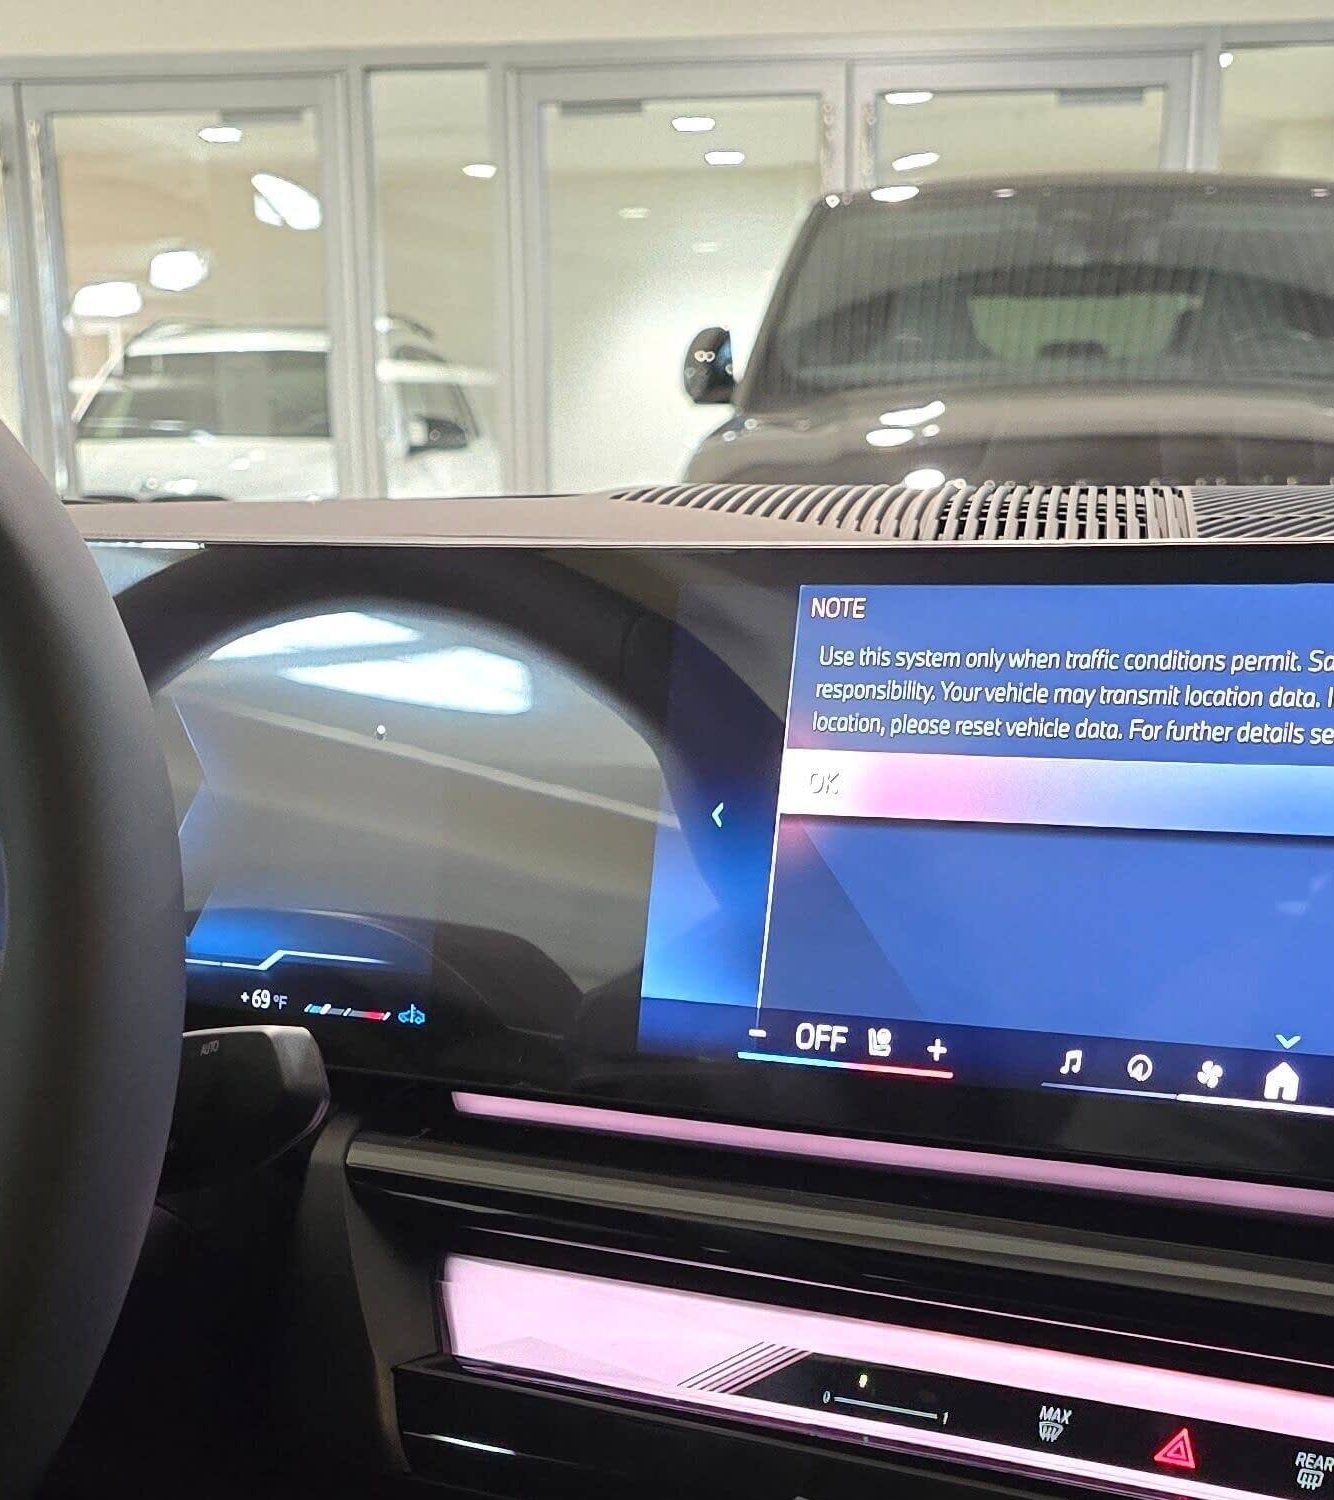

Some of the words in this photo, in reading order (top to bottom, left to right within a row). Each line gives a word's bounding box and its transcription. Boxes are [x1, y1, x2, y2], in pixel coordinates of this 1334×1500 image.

[810, 597, 866, 619] NOTE
[819, 645, 855, 667] Use
[859, 646, 891, 668] this
[895, 648, 961, 671] system
[965, 648, 1005, 673] only
[1008, 648, 1061, 670] when
[1065, 649, 1120, 671] traffic
[1123, 649, 1227, 672] conditions
[1230, 649, 1302, 675] permit.
[815, 679, 937, 705] responsibility.
[940, 680, 984, 702] Your
[984, 682, 1049, 704] vehicle
[1053, 686, 1097, 709] may
[1099, 685, 1181, 706] transmit
[1184, 684, 1264, 708] location
[1268, 686, 1321, 709] data.
[812, 711, 886, 737] location,
[889, 713, 951, 738] please
[955, 718, 1003, 738] reset
[1005, 718, 1071, 739] vehicle
[1075, 718, 1123, 741] data.
[1128, 718, 1163, 742] For
[1165, 719, 1234, 743] further
[1236, 721, 1305, 745] details
[795, 1021, 849, 1053] OFF
[1039, 1405, 1072, 1425] MAX
[1295, 1451, 1334, 1472] REAR
